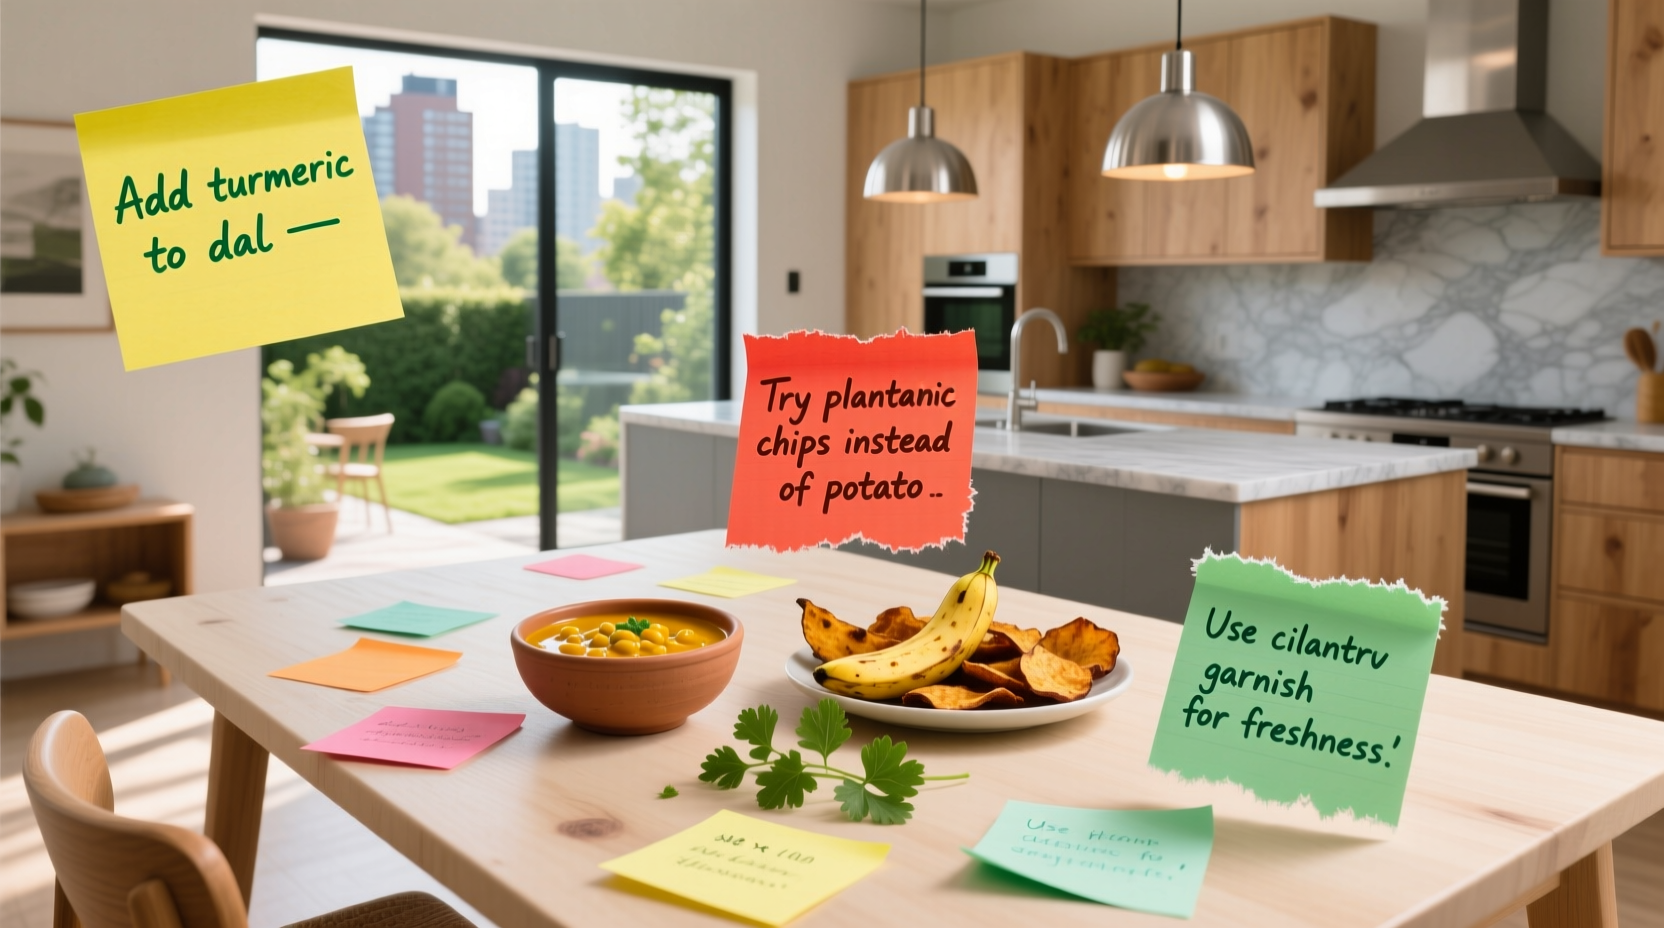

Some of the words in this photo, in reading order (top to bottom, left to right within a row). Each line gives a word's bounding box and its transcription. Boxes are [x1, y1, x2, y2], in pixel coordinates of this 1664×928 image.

[114, 168, 193, 225] Add
[207, 151, 355, 203] turmeric
[143, 236, 187, 274] to
[208, 212, 274, 264] dal
[759, 376, 812, 426] Try
[822, 376, 957, 424] plantanic
[756, 424, 831, 469] chips
[844, 420, 953, 455] instead
[779, 471, 815, 507] of
[1205, 606, 1258, 645] Use
[1199, 663, 1314, 704] garnish
[1182, 694, 1230, 729] for
